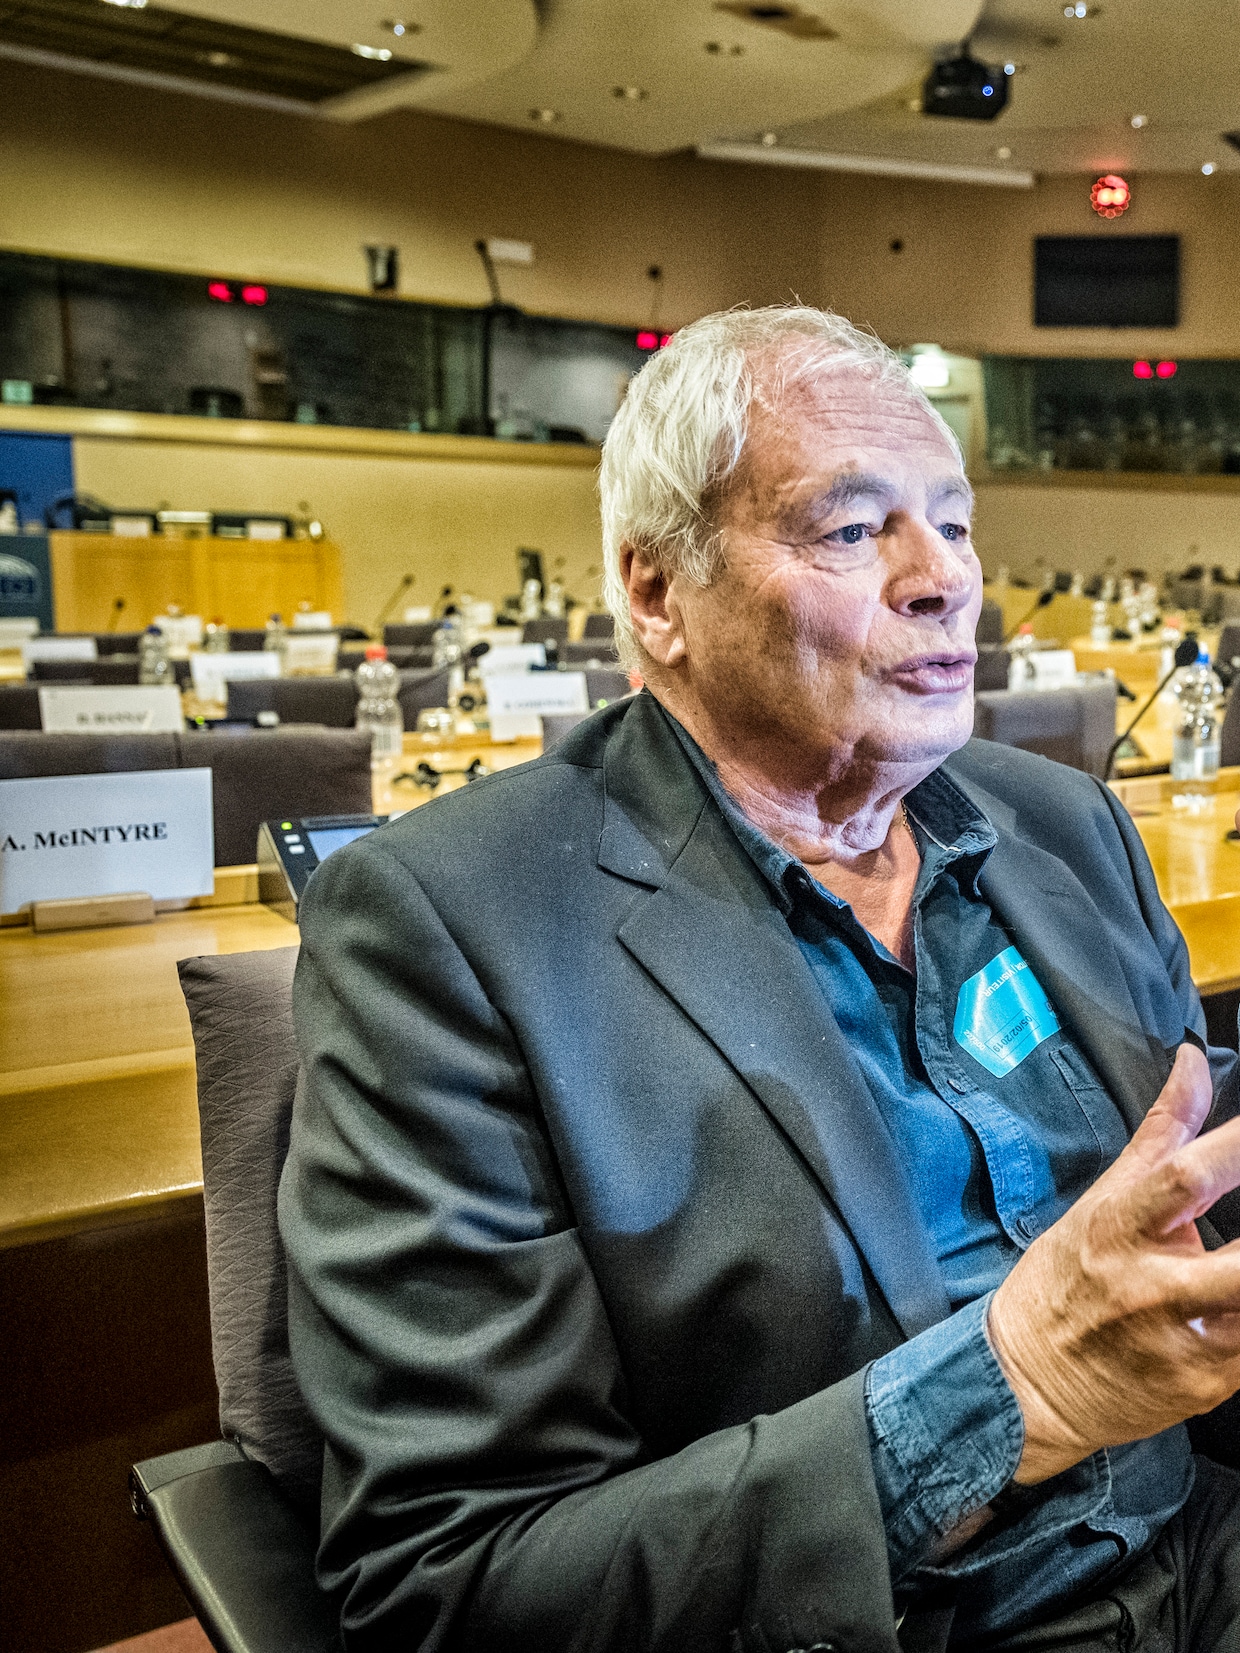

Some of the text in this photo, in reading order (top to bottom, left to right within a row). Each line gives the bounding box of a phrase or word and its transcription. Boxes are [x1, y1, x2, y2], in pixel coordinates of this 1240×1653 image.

[1, 821, 168, 851] A. McINTYRE
[983, 968, 1016, 997] VISITEUR
[992, 1015, 1033, 1053] 05/02/2019
